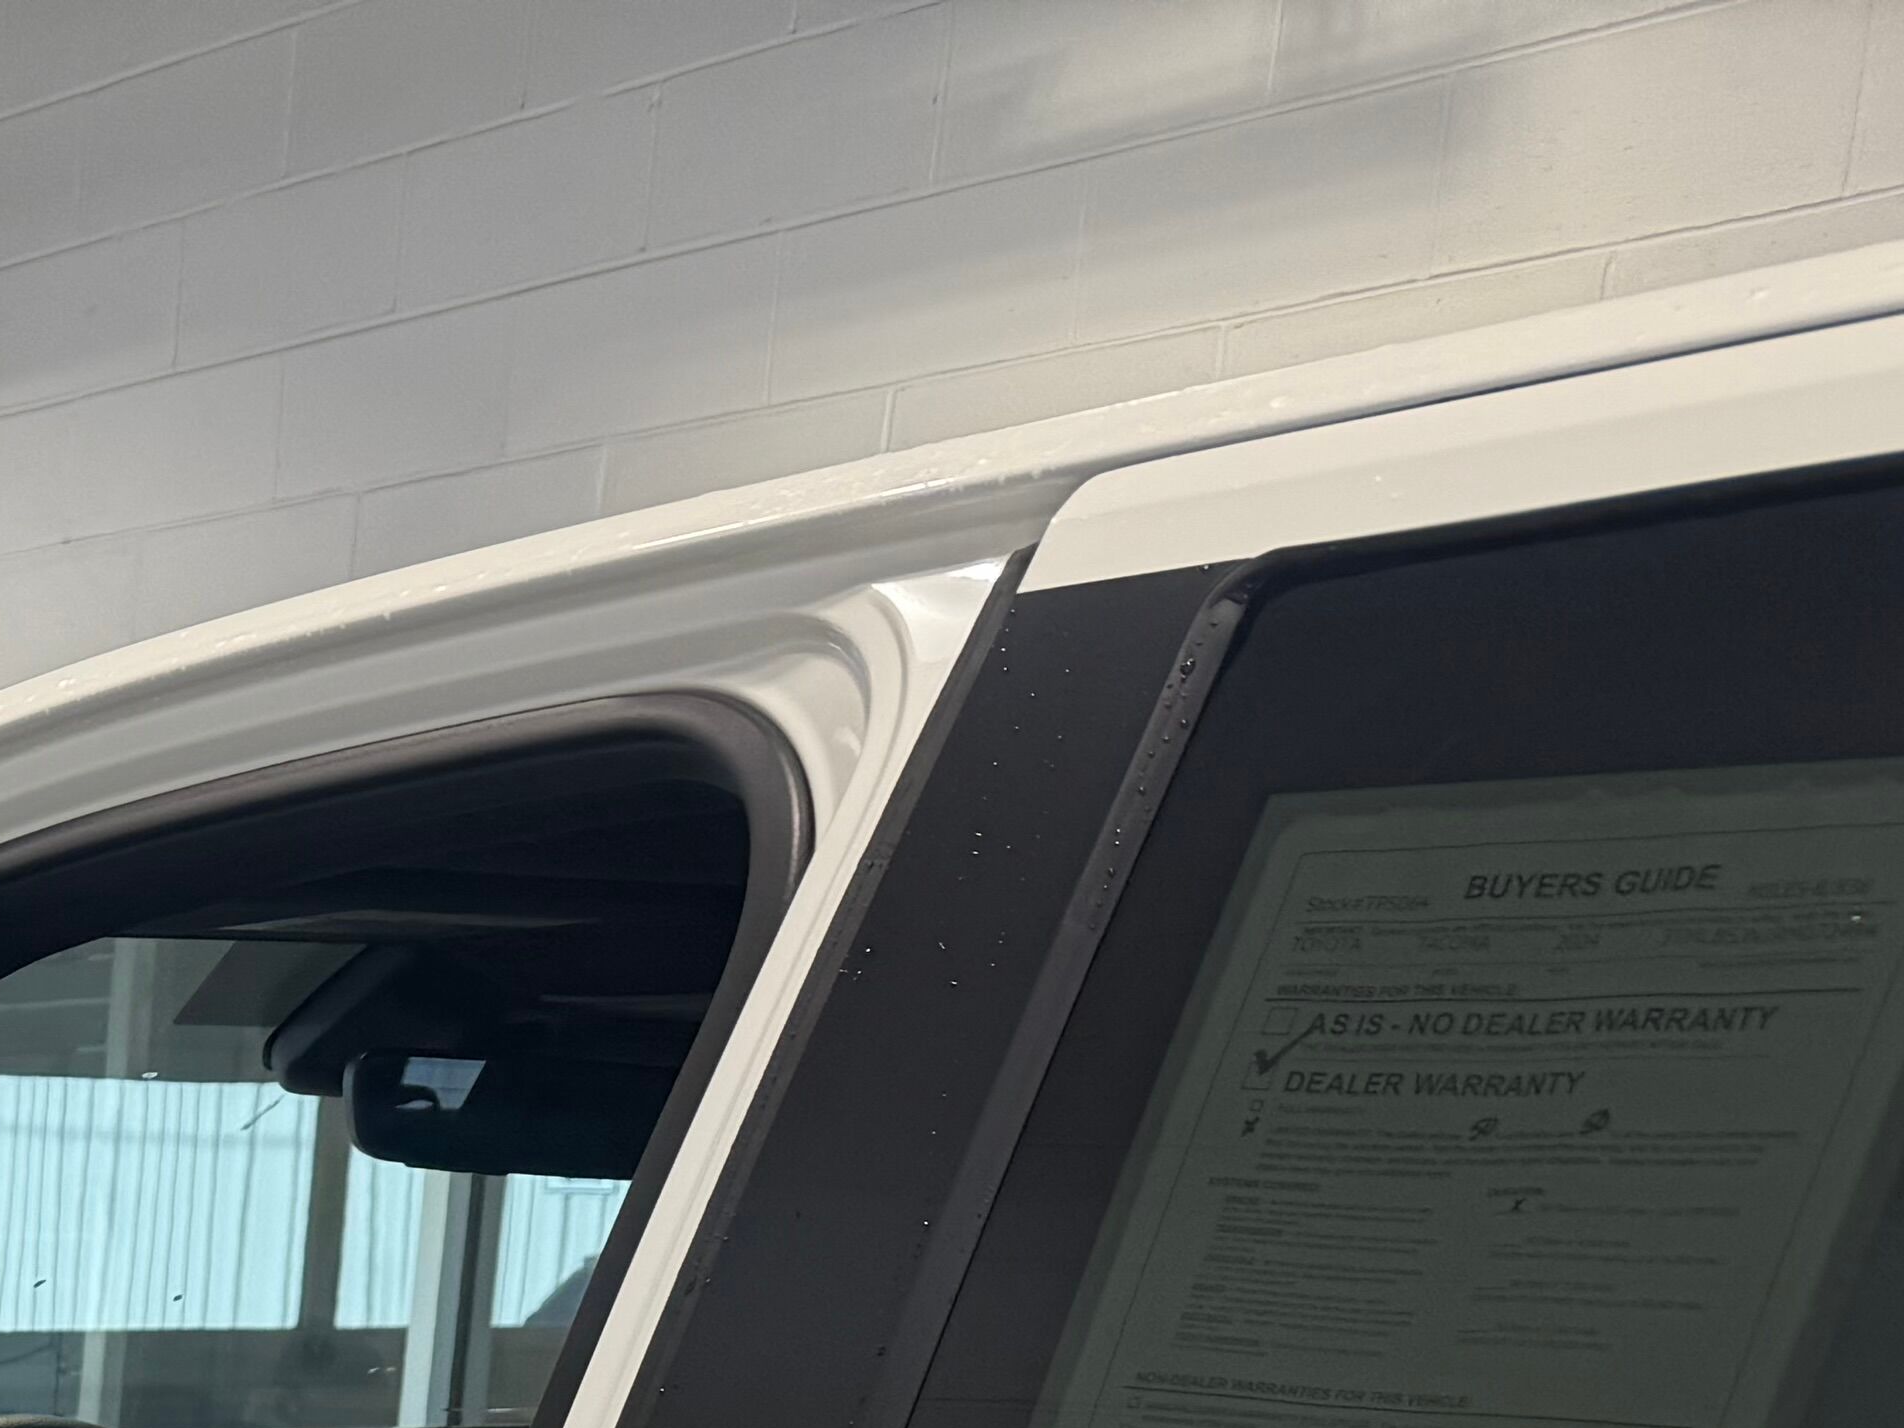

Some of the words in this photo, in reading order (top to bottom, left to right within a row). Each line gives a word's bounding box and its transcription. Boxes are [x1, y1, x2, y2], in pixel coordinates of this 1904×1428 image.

[1463, 871, 1604, 900] BUYERS
[1614, 863, 1723, 896] GUIDE
[1309, 1012, 1350, 1035] AS
[1355, 1012, 1385, 1035] IS
[1408, 1012, 1455, 1035] NO
[1461, 1010, 1587, 1036] DEALER
[1594, 1005, 1780, 1032] WARRANTY
[1282, 1070, 1406, 1095] DEALER
[1413, 1071, 1586, 1097] WARRANTY
